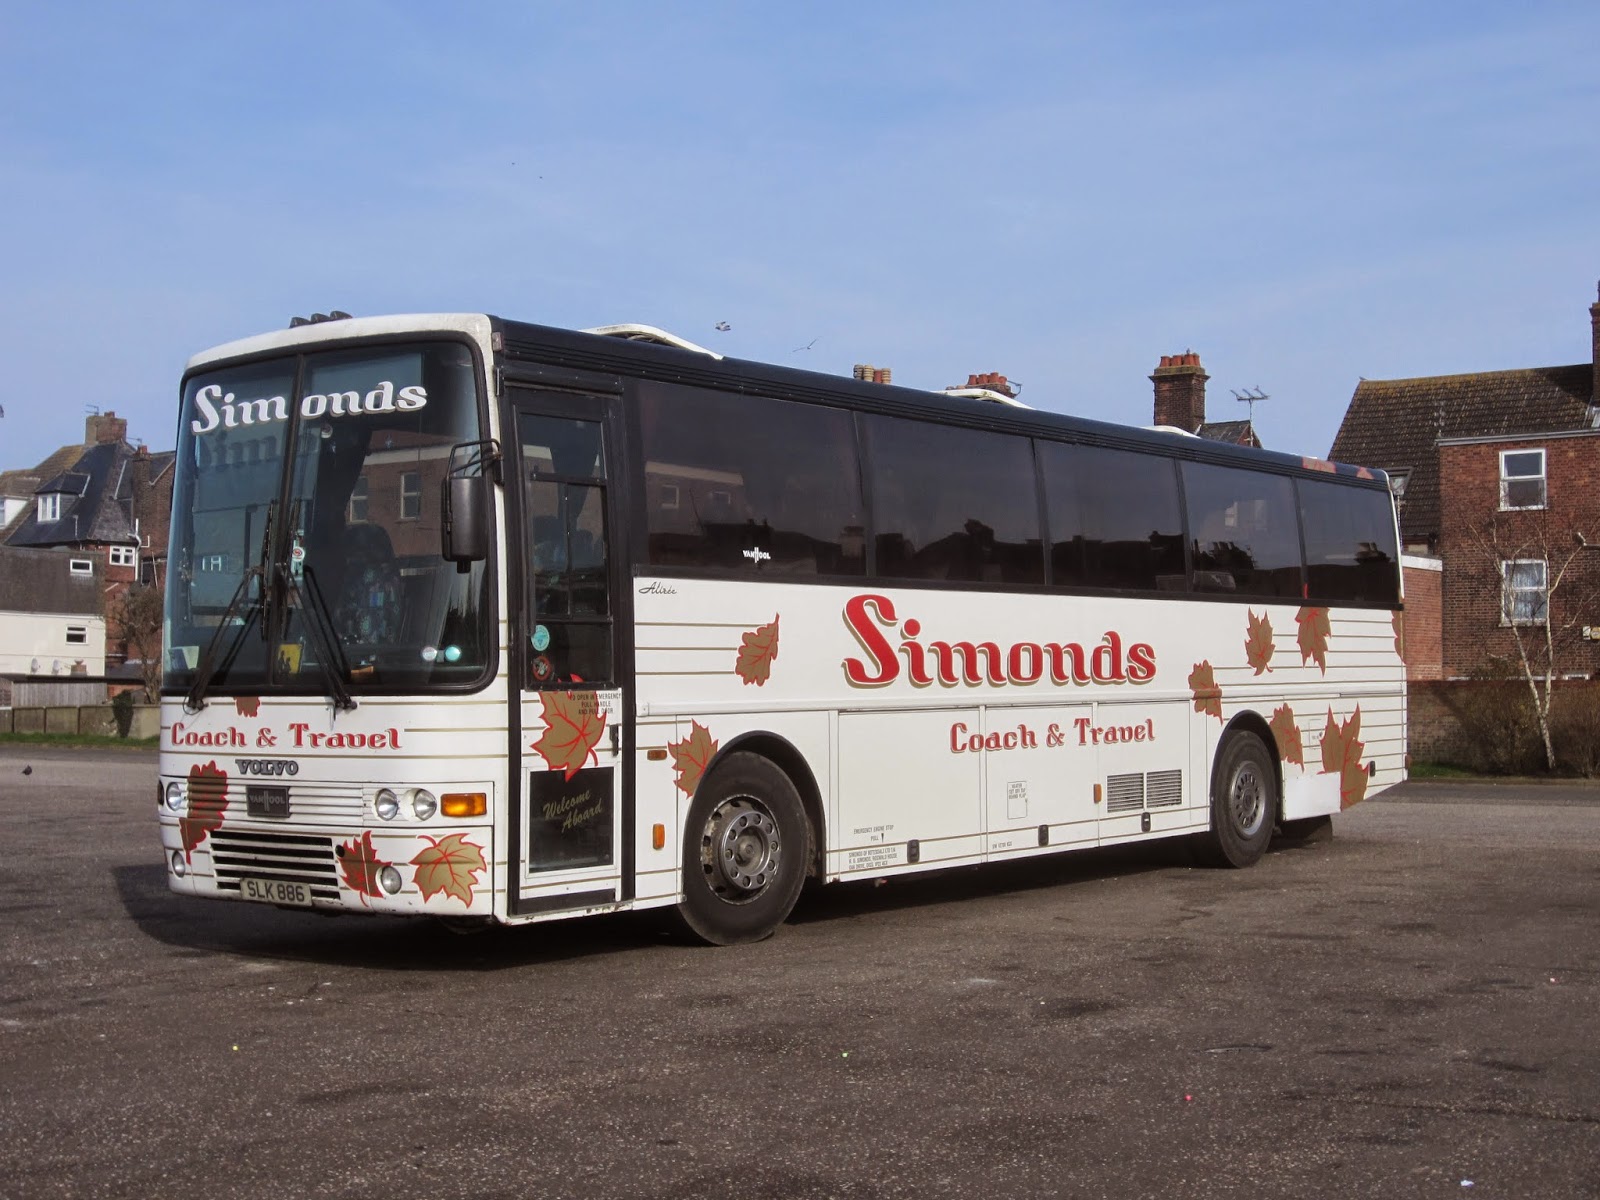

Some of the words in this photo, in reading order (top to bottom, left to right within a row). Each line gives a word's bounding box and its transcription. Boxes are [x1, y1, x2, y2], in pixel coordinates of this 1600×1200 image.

[841, 593, 1157, 689] Simonds
[171, 721, 247, 748] Coach
[256, 727, 277, 747] &
[288, 722, 402, 750] Travel
[950, 722, 1037, 753] Coach
[1046, 723, 1065, 748] &
[1074, 717, 1156, 746] Travel
[235, 759, 299, 776] VOLVO
[543, 790, 591, 820] Welcome
[562, 797, 603, 833] Aboard
[247, 880, 274, 900] SLK
[277, 883, 305, 902] 886
